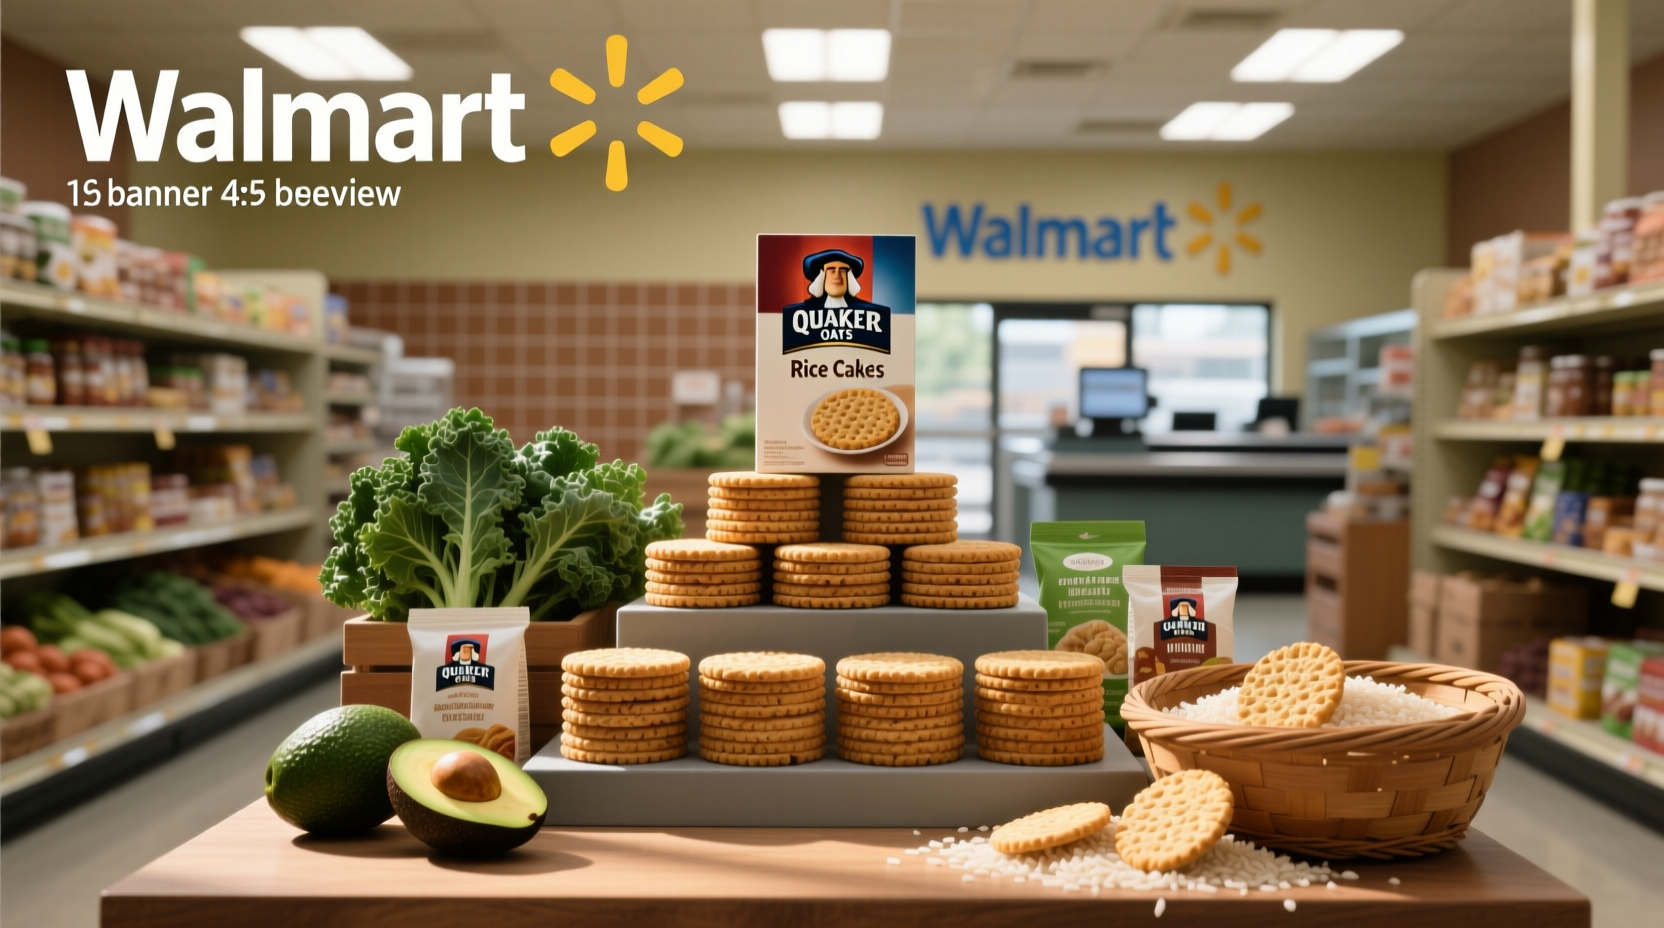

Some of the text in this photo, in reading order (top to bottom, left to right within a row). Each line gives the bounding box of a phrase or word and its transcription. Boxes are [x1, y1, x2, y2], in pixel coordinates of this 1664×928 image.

[922, 201, 1177, 262] Walmart
[792, 308, 883, 336] QUAKER
[820, 329, 853, 341] OATS
[790, 359, 885, 379] Rice Cakes
